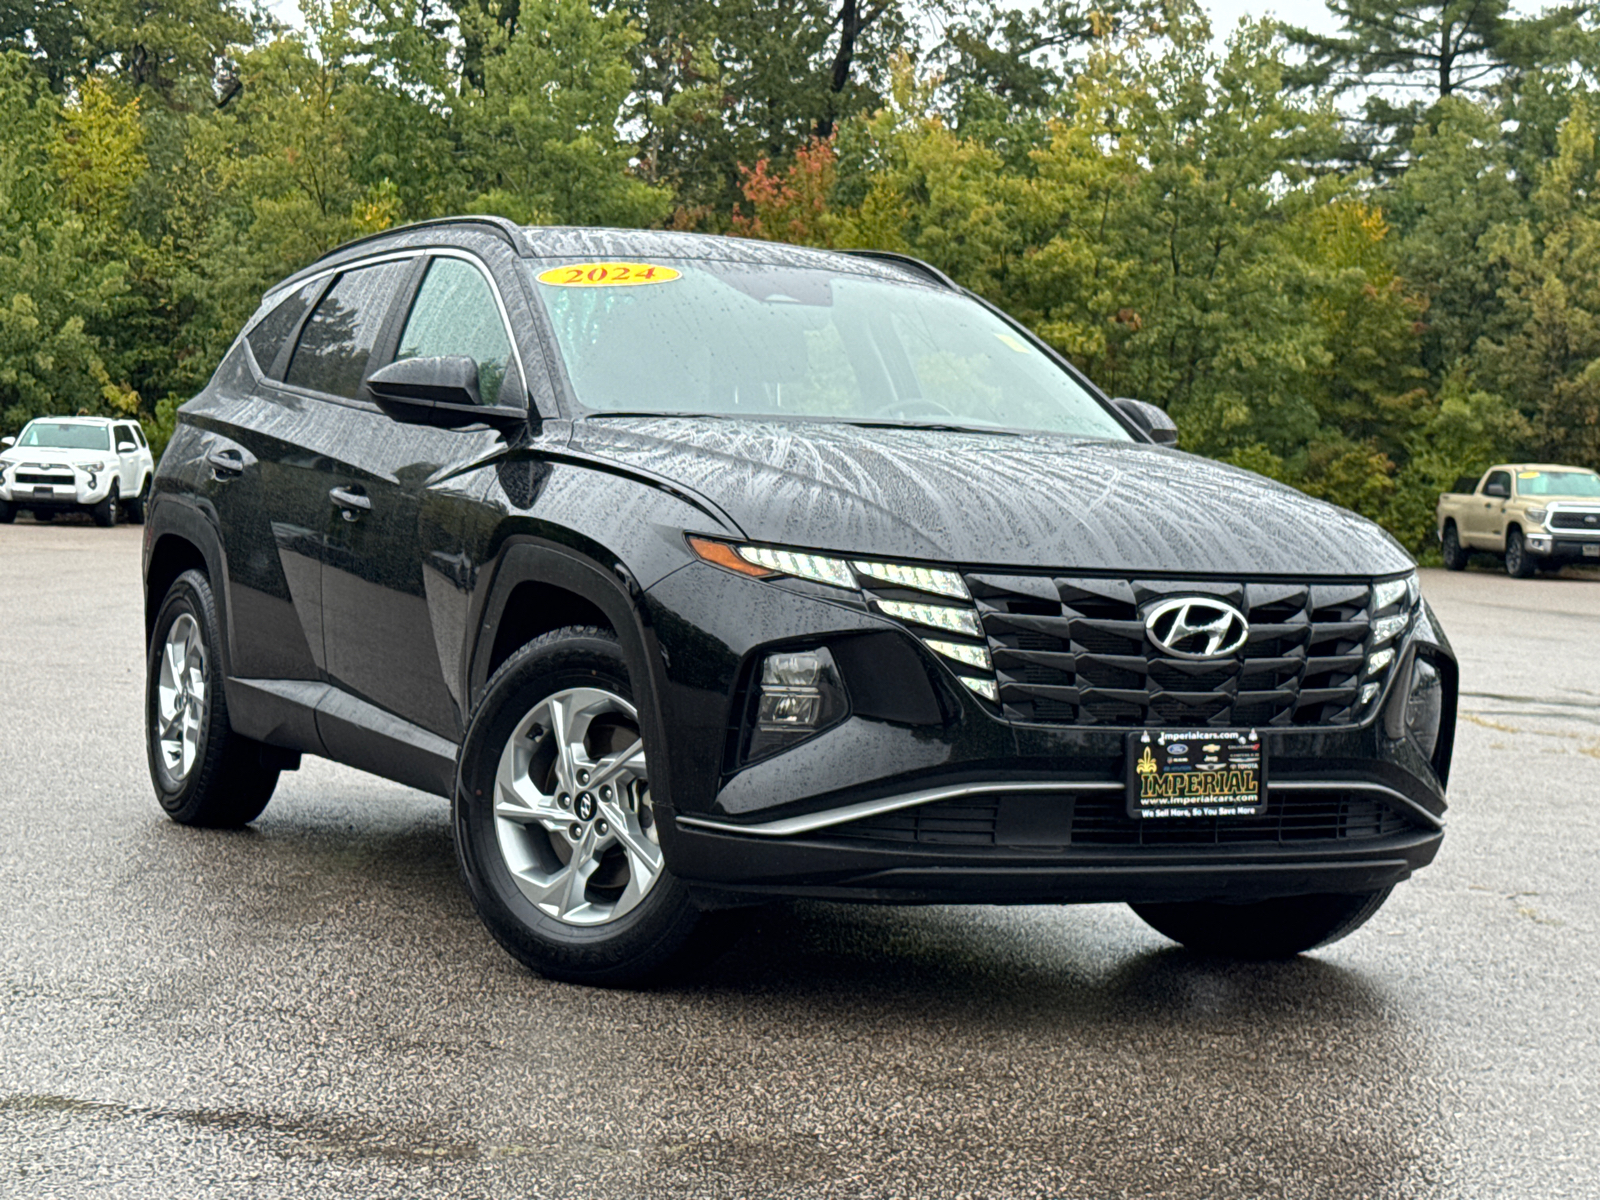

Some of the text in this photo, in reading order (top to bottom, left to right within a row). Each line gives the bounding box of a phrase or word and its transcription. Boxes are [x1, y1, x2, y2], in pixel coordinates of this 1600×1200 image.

[564, 266, 656, 284] 2024
[1141, 771, 1258, 797] IMPERIAL
[1141, 806, 1255, 818] We Sell More, So You Save More
